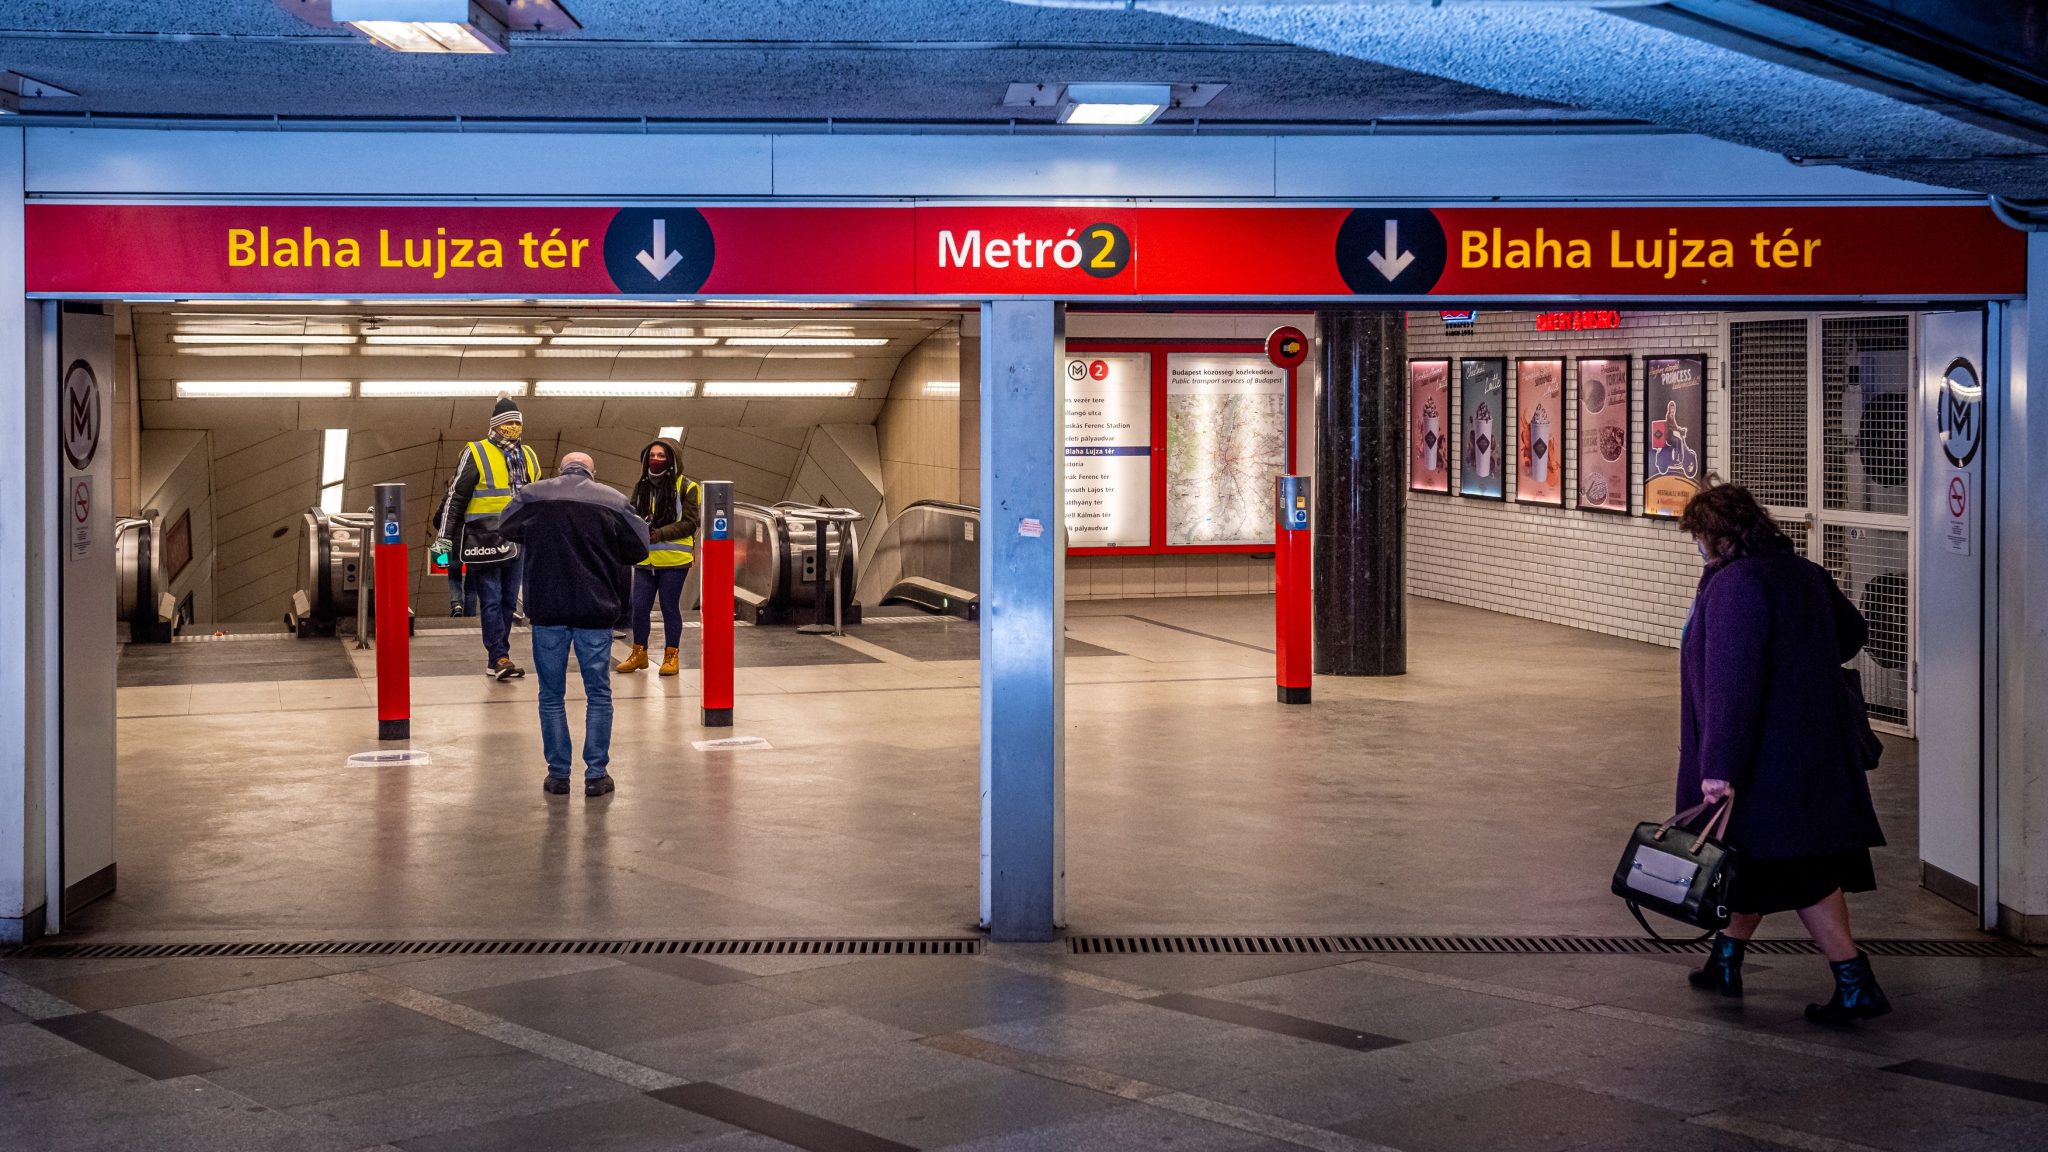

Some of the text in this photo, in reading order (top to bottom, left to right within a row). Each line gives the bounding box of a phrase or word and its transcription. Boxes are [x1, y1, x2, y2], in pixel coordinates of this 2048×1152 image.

[229, 226, 589, 279] Blaha Lujza tér
[938, 228, 1116, 269] Metró 2
[1461, 227, 1821, 279] Blaha Lujza tér
[1094, 364, 1104, 377] 2
[1203, 369, 1234, 377] közösségi
[1235, 368, 1274, 376] közlekedése
[1661, 368, 1692, 386] PRINCESS
[1080, 435, 1115, 443] pályaudvar
[1085, 448, 1103, 456] Lujza
[1065, 499, 1093, 507] atthyány
[1074, 525, 1109, 533] pályaudvar
[464, 546, 497, 556] adidas
